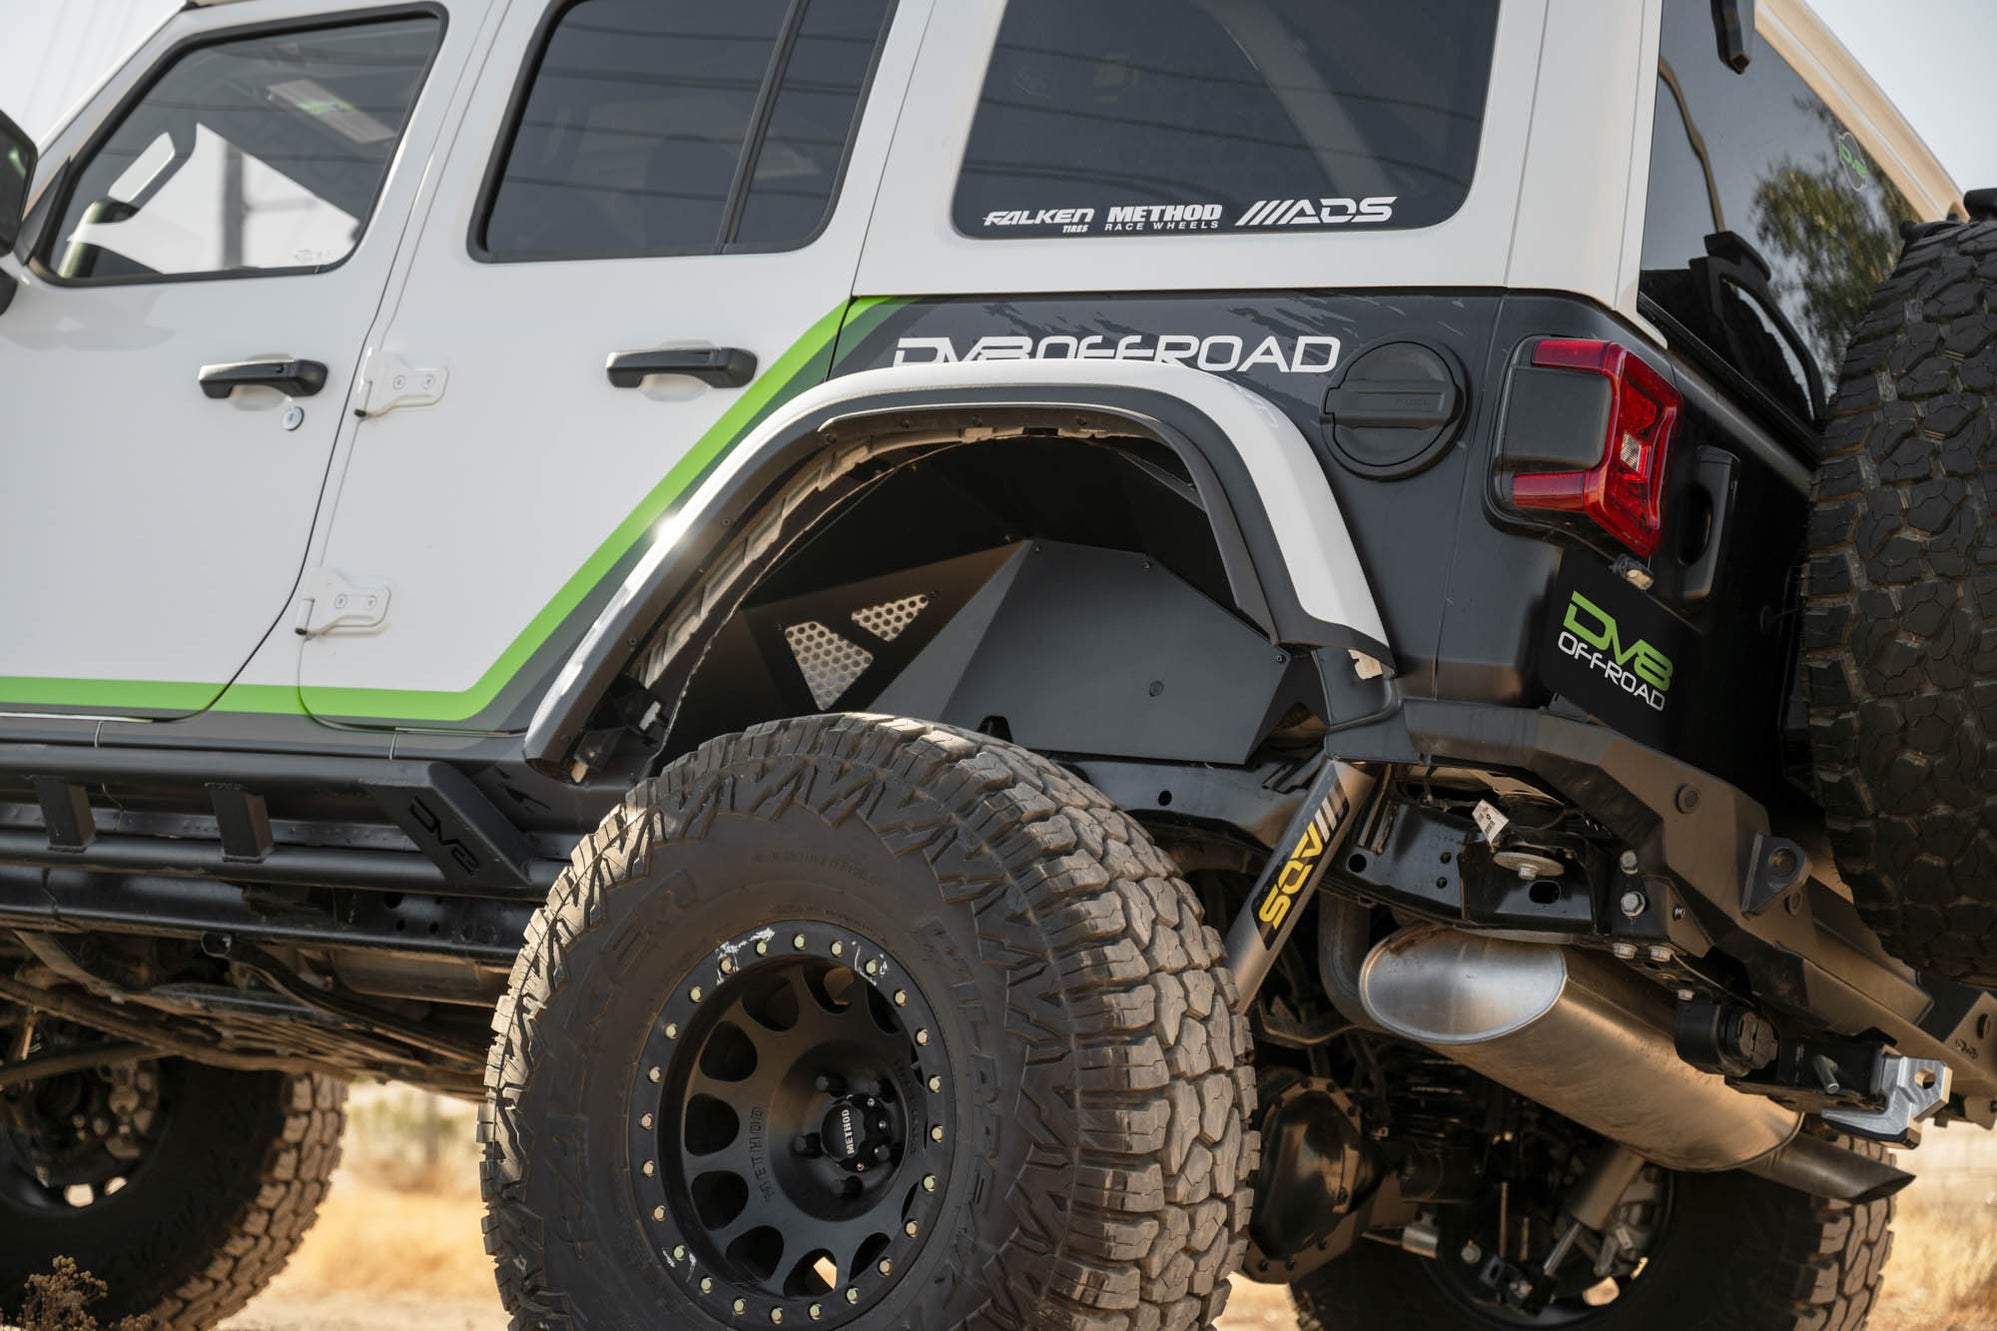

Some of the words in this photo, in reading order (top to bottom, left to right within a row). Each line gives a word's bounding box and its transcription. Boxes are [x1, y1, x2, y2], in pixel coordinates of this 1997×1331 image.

[983, 208, 1095, 226] FALKEN
[1107, 204, 1223, 223] METHOD
[1062, 224, 1089, 234] TIRES
[1104, 223, 1145, 232] RACE
[1153, 220, 1219, 230] WHEELS
[1563, 590, 1674, 692] DV8
[1258, 820, 1324, 931] ADS
[841, 1109, 855, 1155] METHOD
